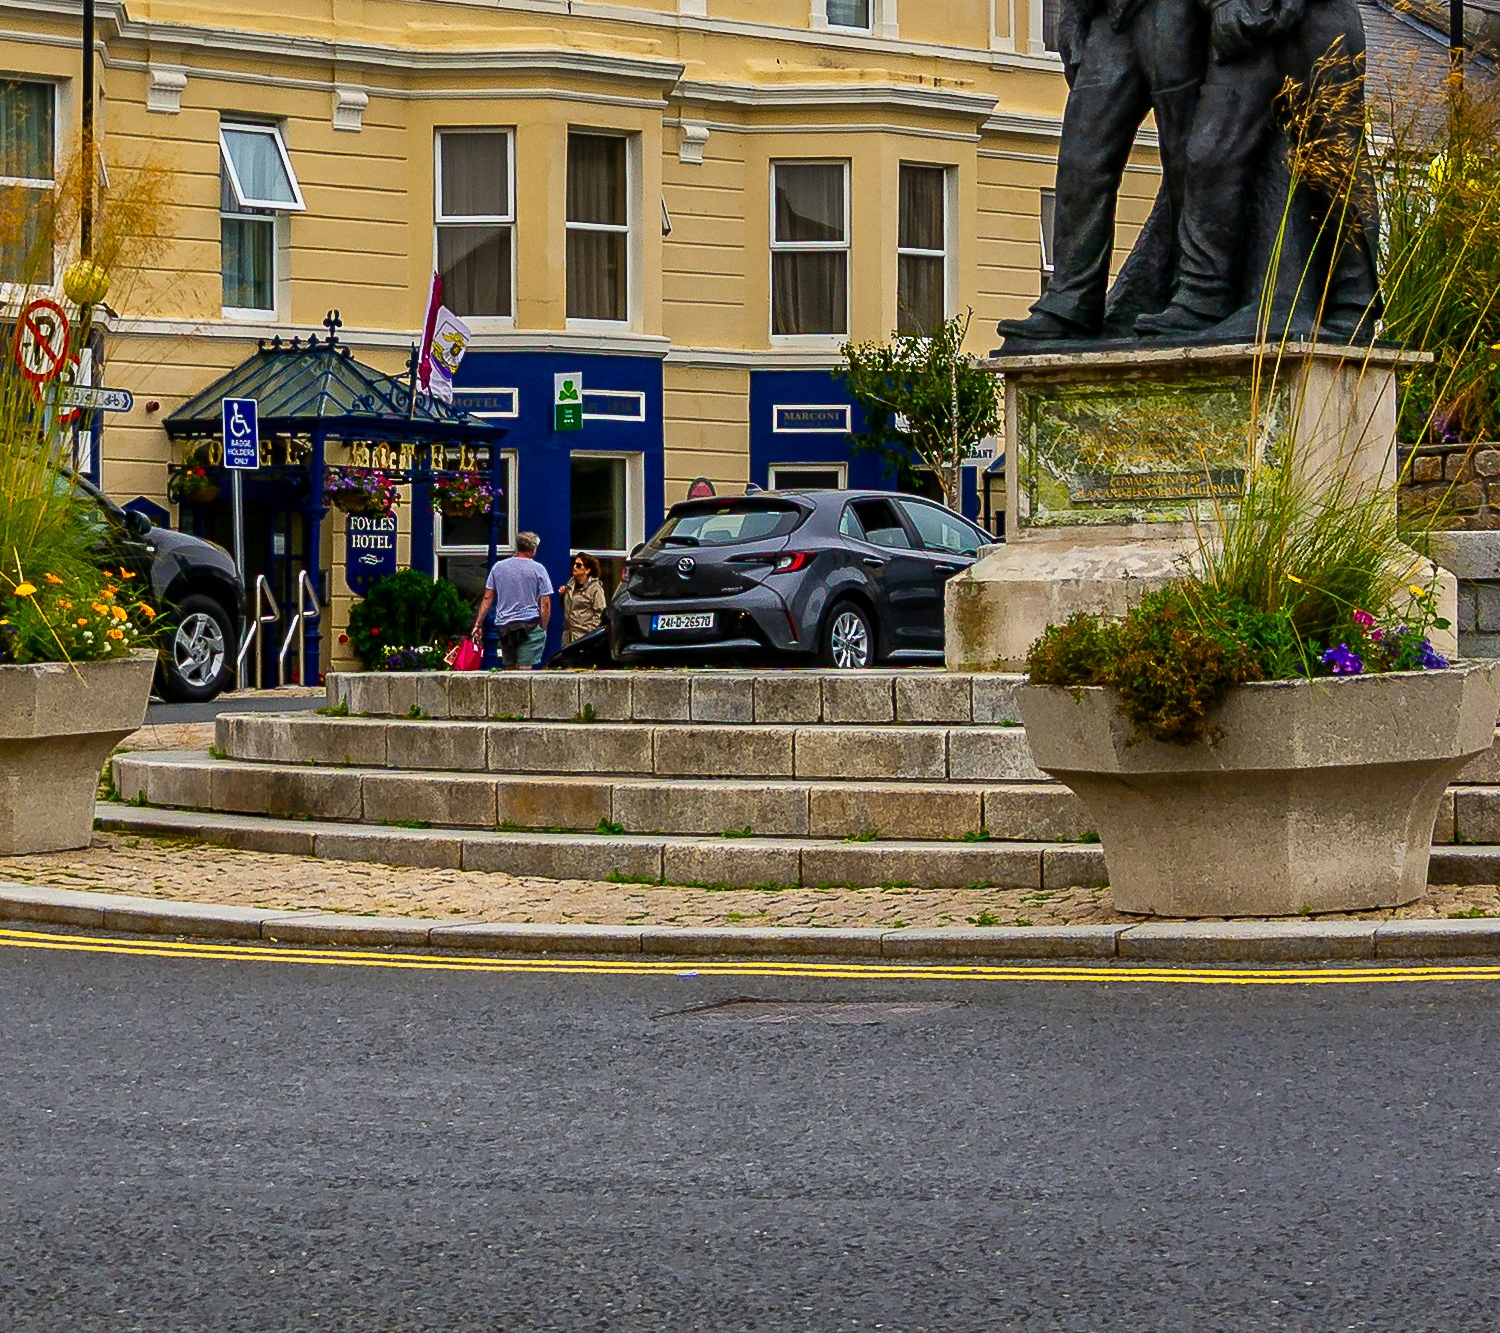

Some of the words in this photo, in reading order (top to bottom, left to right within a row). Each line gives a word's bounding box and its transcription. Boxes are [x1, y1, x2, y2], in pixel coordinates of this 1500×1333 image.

[451, 397, 502, 409] HOTEL
[784, 412, 840, 421] MARCONI
[231, 439, 251, 447] BADGE
[228, 448, 255, 456] HOLDERS
[234, 457, 249, 465] ONLY
[351, 534, 393, 549] HOTEL
